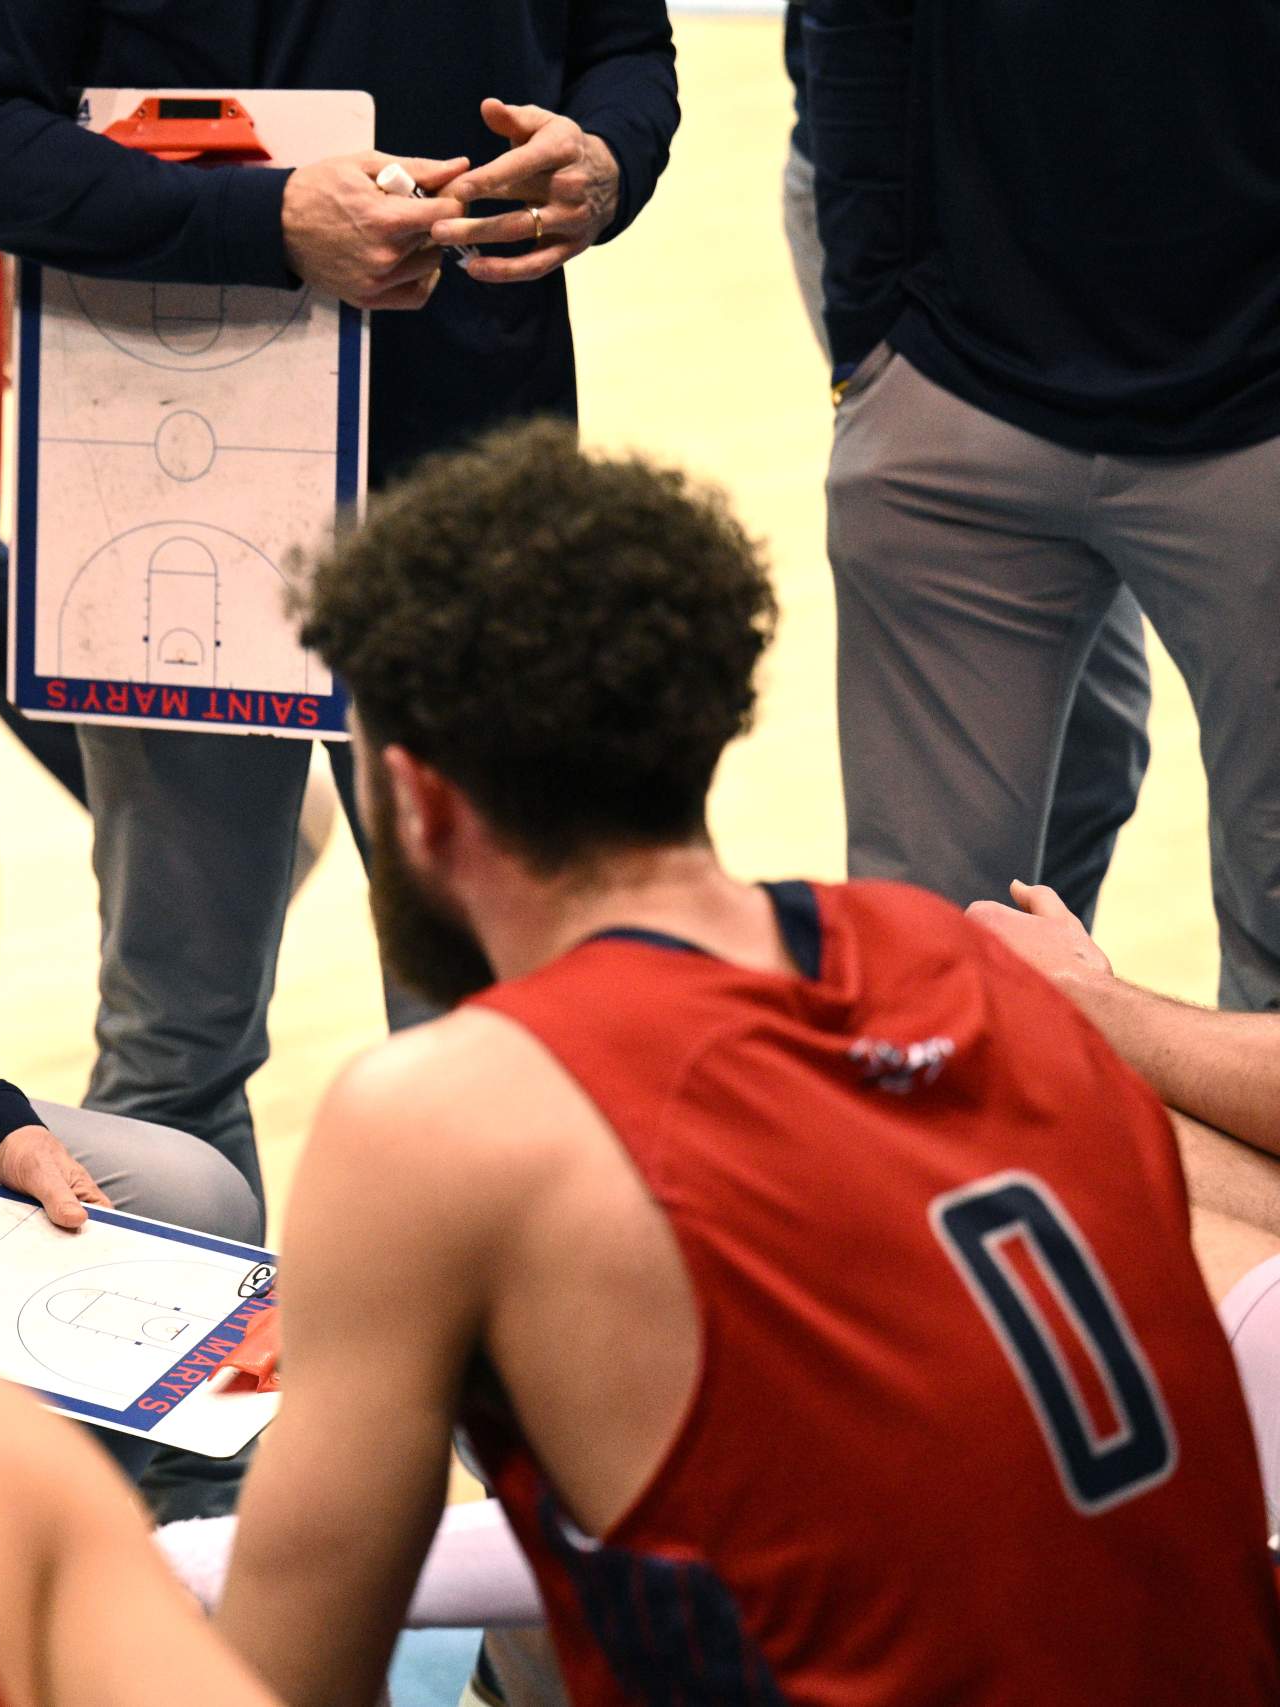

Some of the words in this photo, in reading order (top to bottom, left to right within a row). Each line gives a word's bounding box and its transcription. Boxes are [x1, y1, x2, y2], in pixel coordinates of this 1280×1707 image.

[47, 680, 188, 717] MARY'S
[203, 691, 320, 726] SAINT
[928, 1169, 1178, 1516] 0
[137, 1336, 238, 1414] MARY'S
